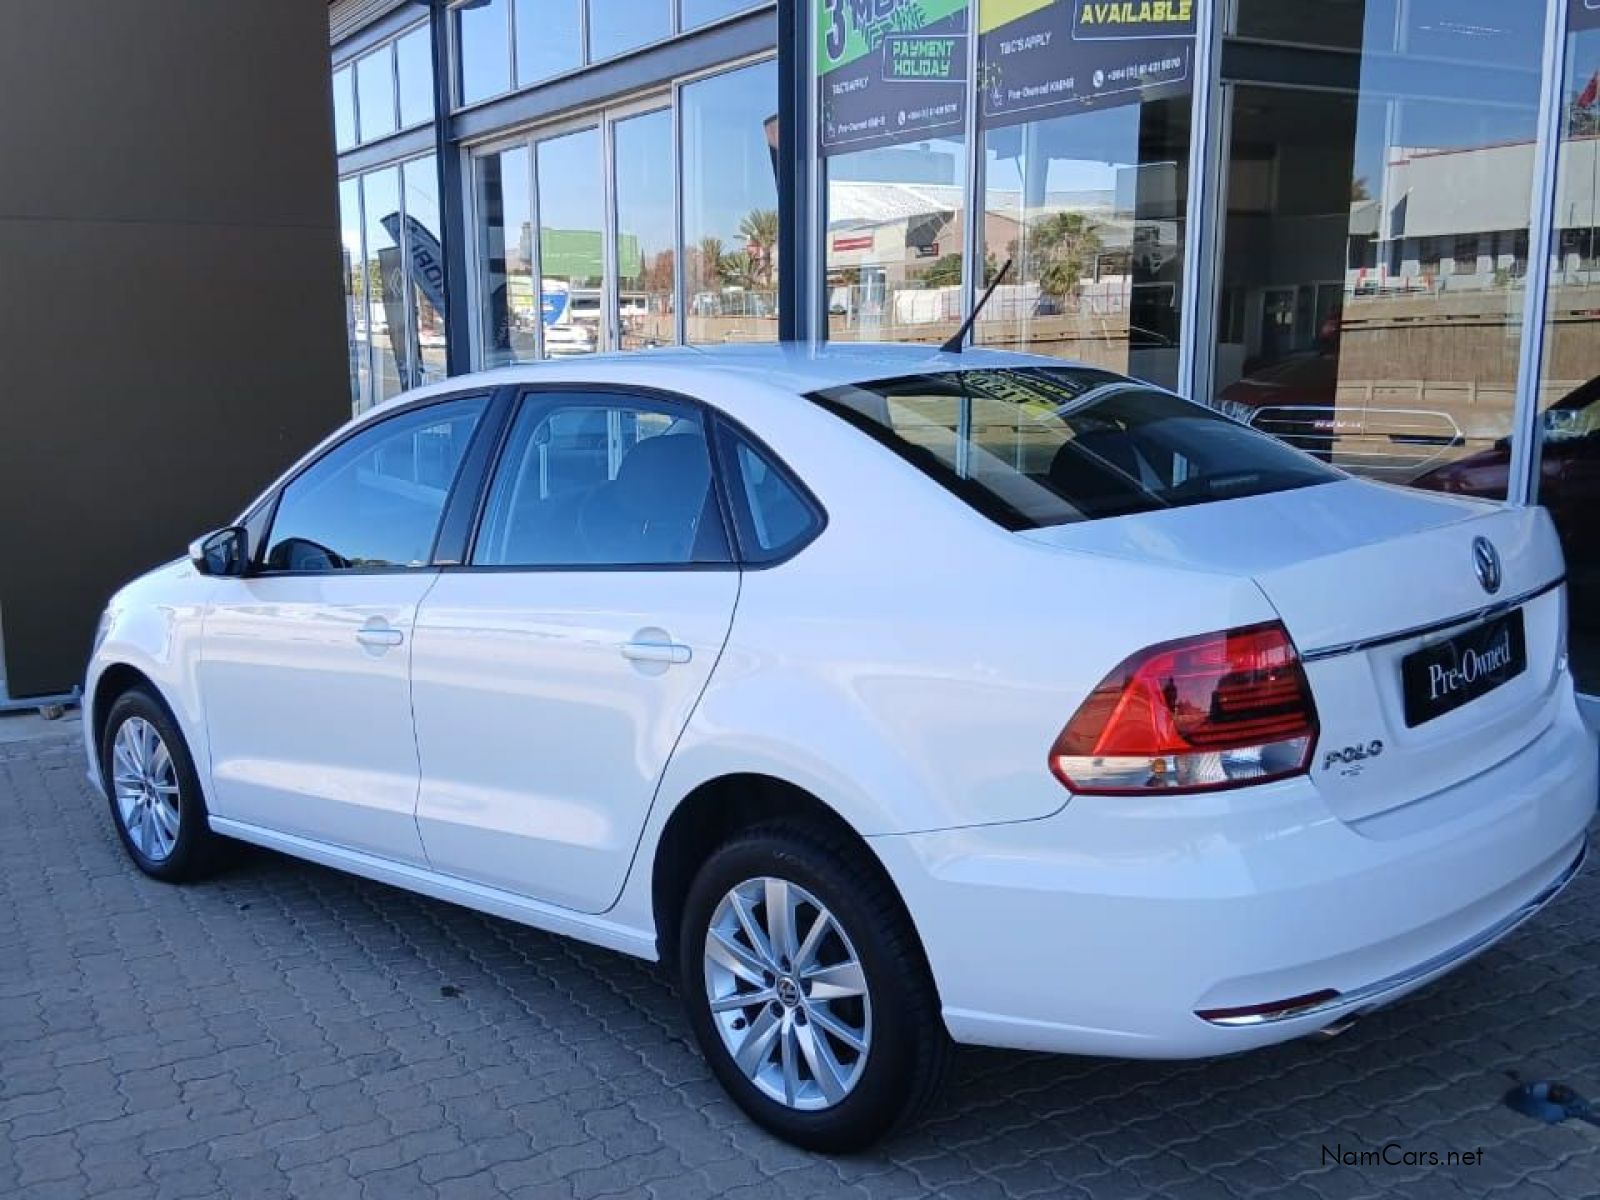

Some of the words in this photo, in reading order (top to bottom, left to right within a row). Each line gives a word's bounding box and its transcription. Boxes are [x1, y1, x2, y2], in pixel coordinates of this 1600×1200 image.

[1080, 1, 1192, 24] AVAILABLE
[892, 40, 954, 58] PAYMENT
[893, 59, 951, 77] HOLIDAY
[1428, 627, 1511, 701] Pre-Owned
[1321, 740, 1383, 770] POLO
